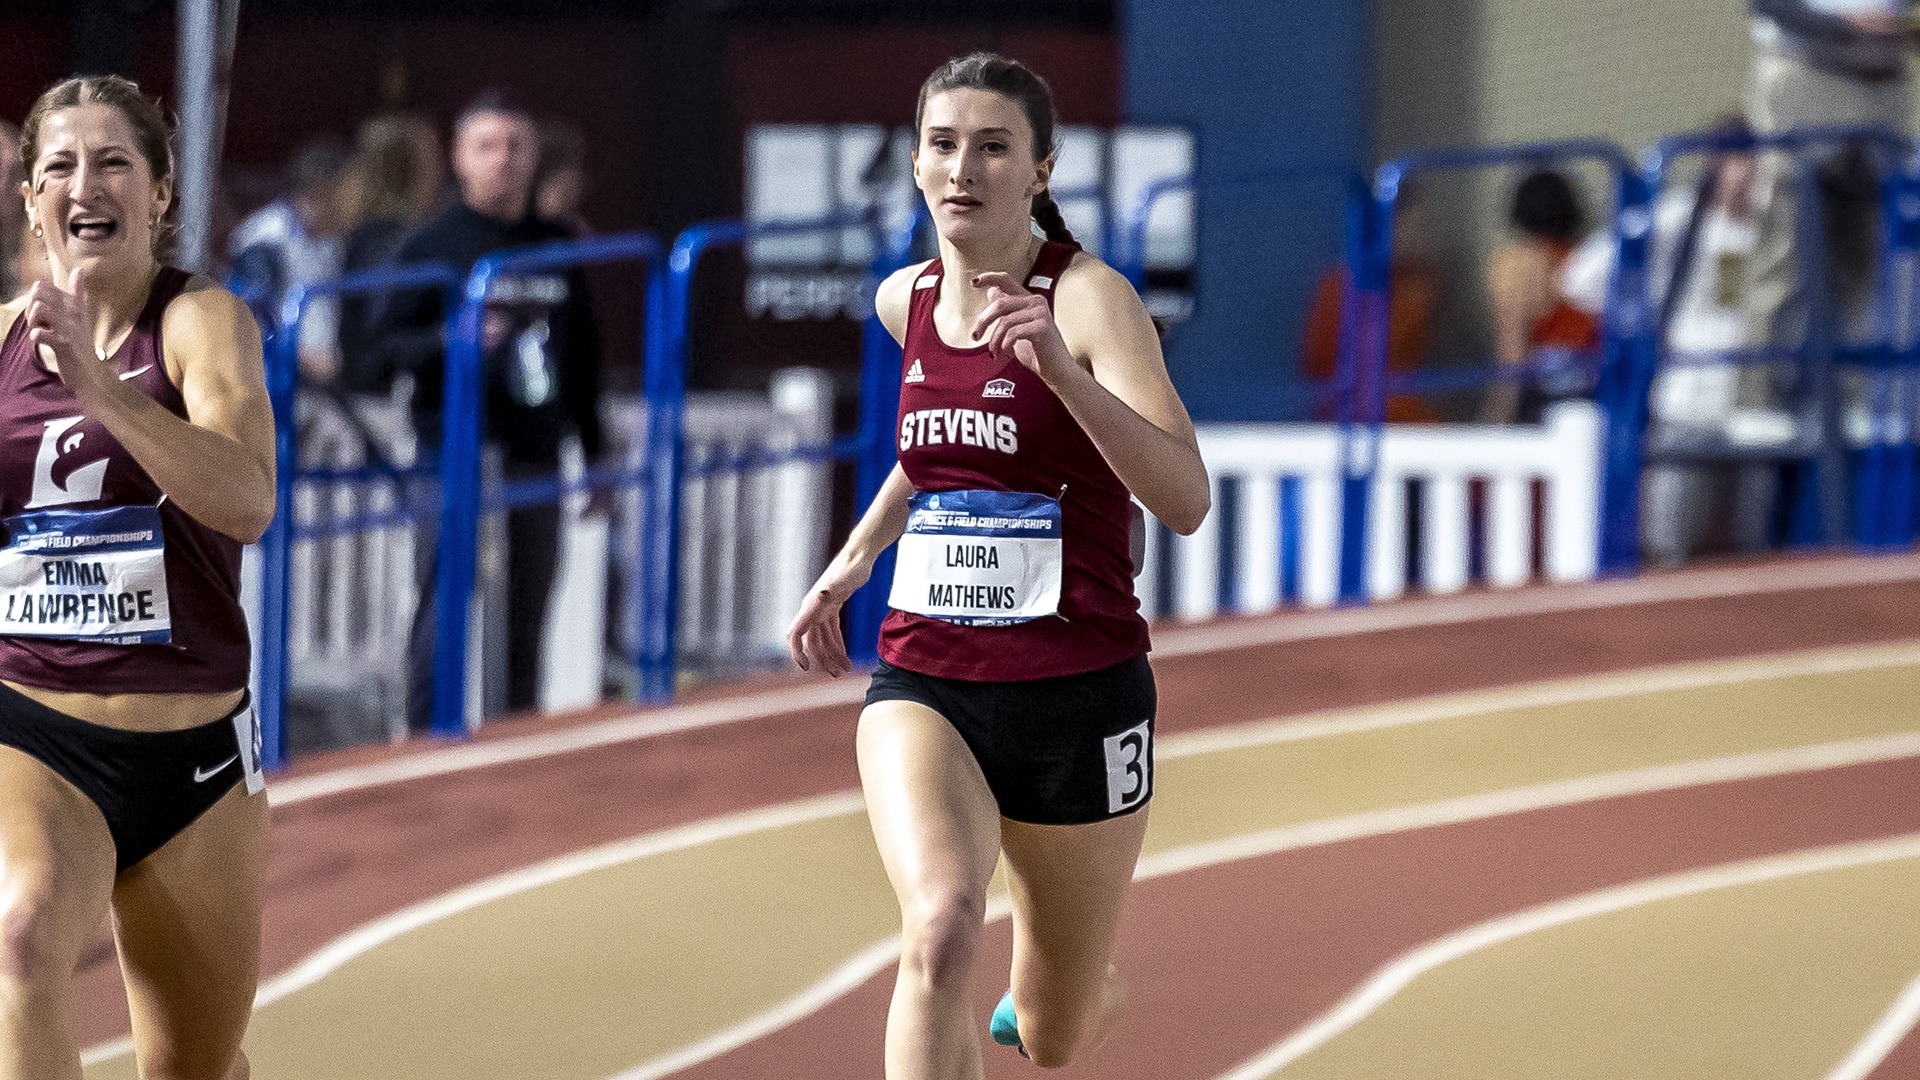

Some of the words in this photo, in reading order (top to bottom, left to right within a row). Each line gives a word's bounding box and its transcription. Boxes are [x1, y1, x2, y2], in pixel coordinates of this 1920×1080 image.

[985, 386, 1011, 397] MAC
[900, 408, 1018, 455] STEVENS
[954, 515, 977, 529] FIELD
[977, 516, 1053, 530] CHAMPIONSHIPS
[48, 535, 71, 549] FIELD
[72, 529, 153, 548] CHAMPIONSHIPS
[946, 543, 1000, 569] LAURA
[42, 560, 108, 586] EMMA
[5, 589, 156, 625] LAWRENCE
[928, 583, 1015, 609] MATHEWS
[1119, 731, 1143, 805] 3
